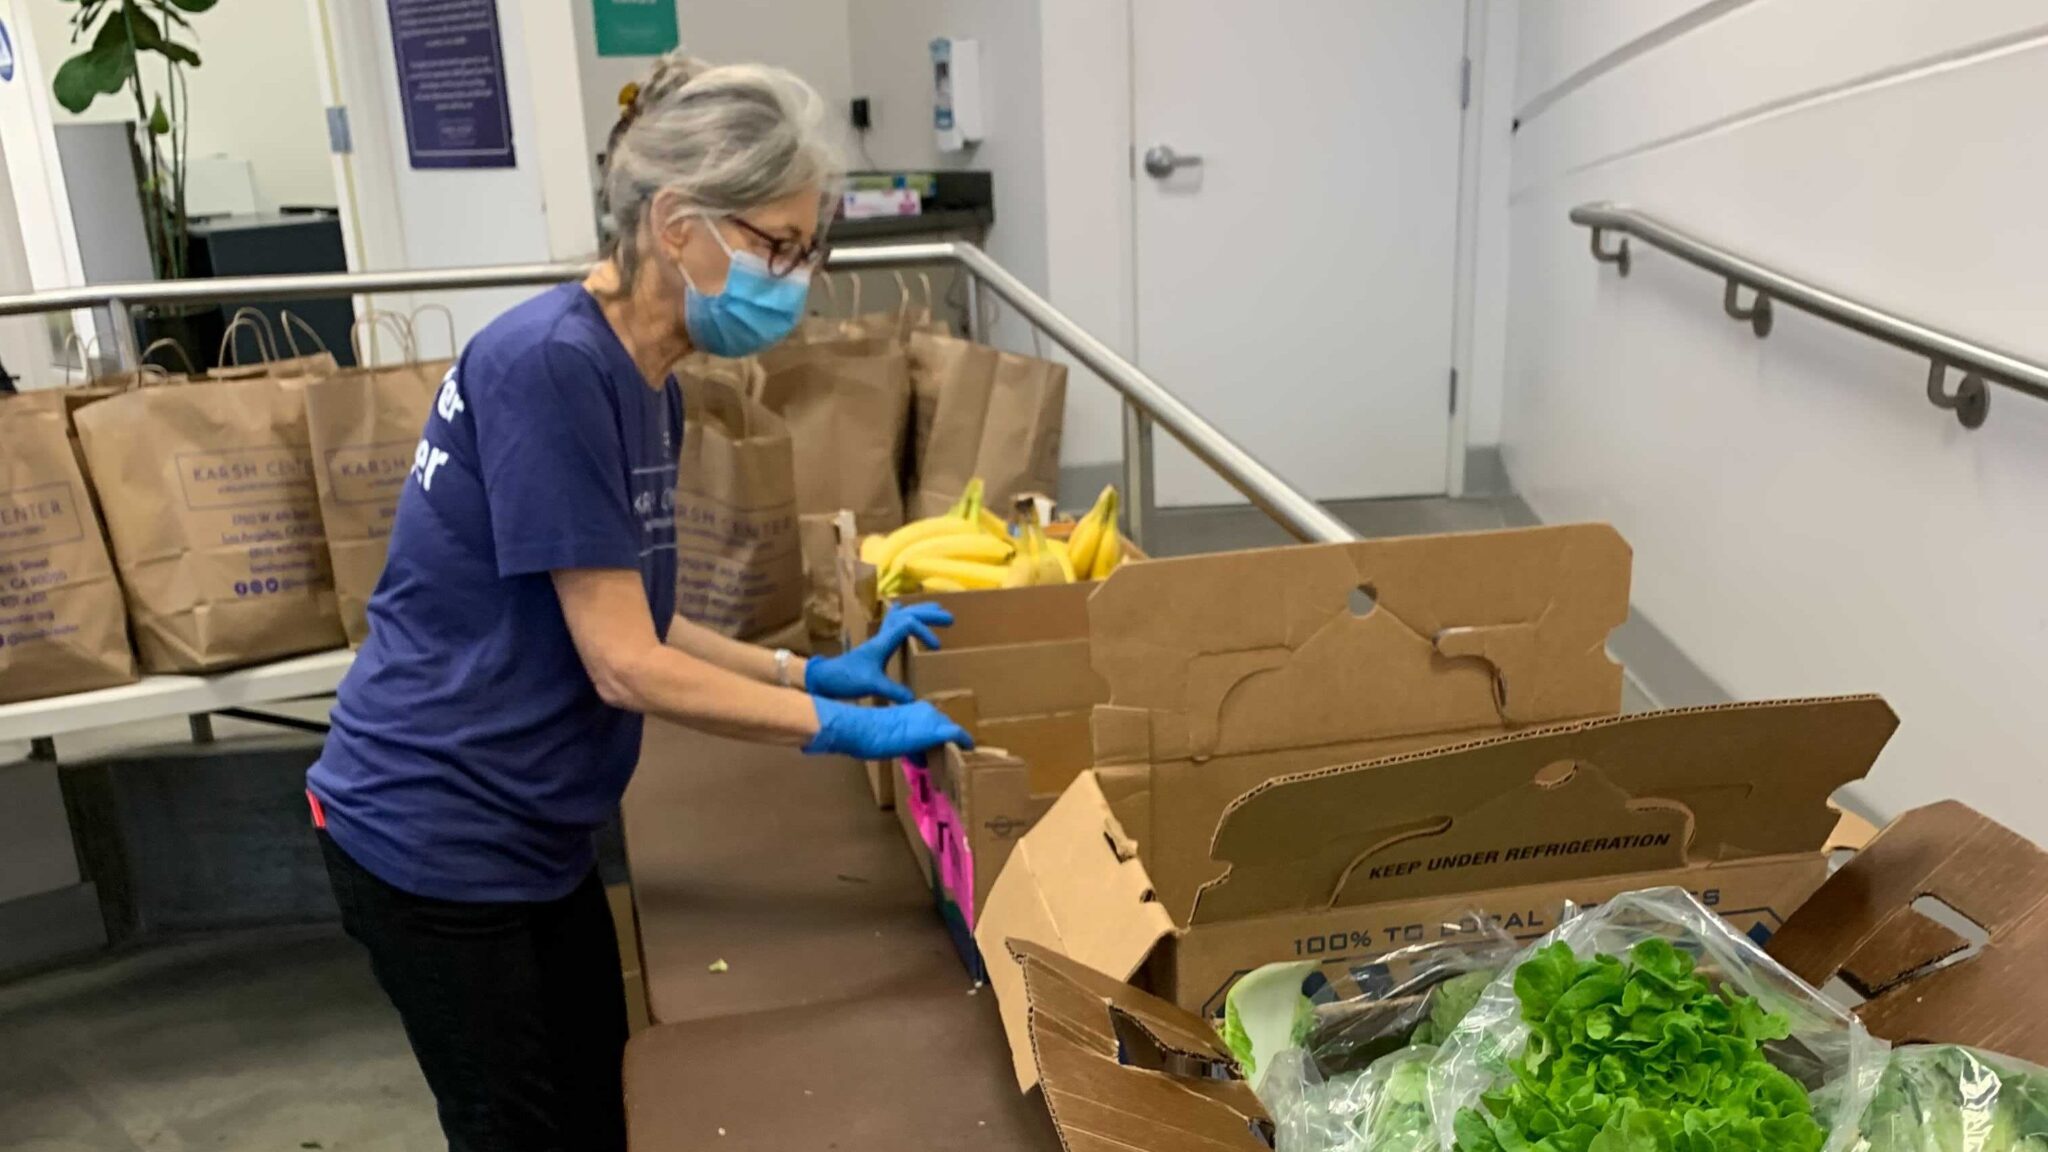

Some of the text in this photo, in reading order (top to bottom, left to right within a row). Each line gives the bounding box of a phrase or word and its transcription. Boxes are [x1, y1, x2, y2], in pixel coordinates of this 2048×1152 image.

[193, 459, 313, 481] KARSH CENTE
[341, 457, 406, 476] KARSH
[0, 500, 62, 526] ENTER
[677, 503, 716, 524] RSH
[1369, 833, 1671, 880] KEEP UNDER REFRIGERATION
[1294, 929, 1373, 956] 100%
[1383, 923, 1424, 942] TO
